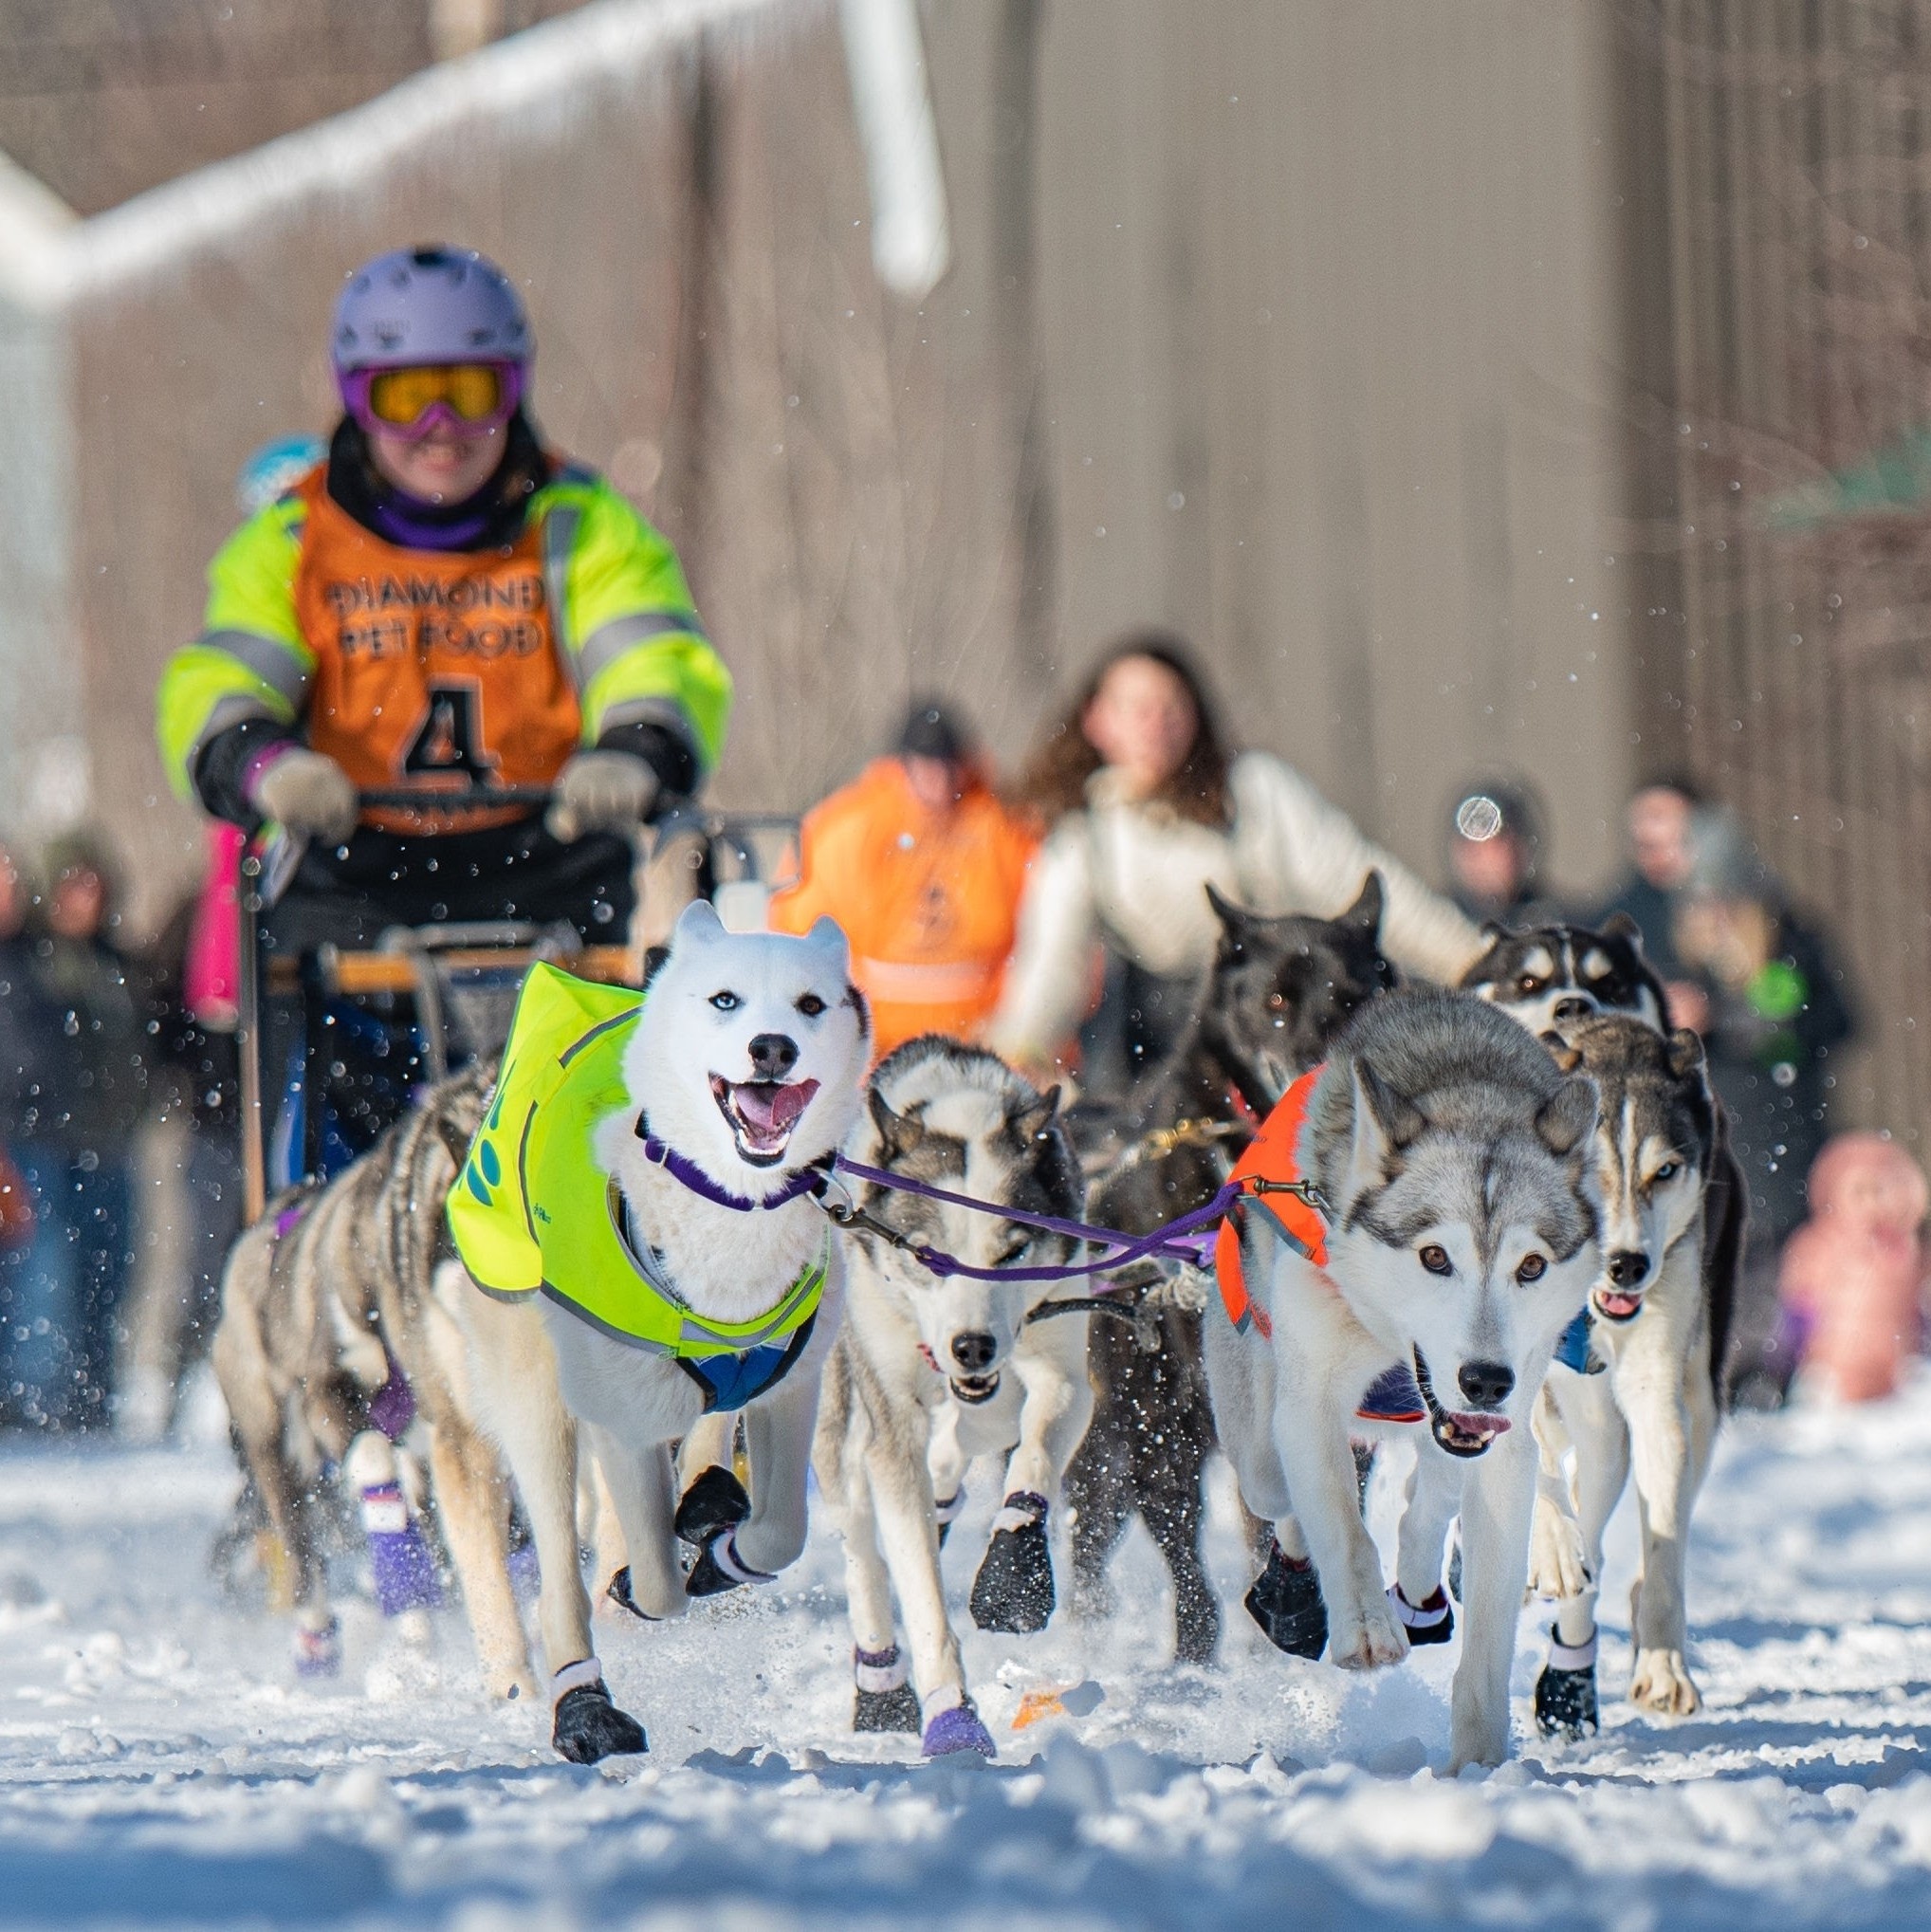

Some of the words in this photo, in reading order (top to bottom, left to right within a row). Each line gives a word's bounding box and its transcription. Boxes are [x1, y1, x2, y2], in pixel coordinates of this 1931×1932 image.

[325, 576, 544, 613] DIAMOND
[340, 621, 408, 655] PET
[420, 621, 543, 656] FOOD
[399, 682, 497, 793] 4
